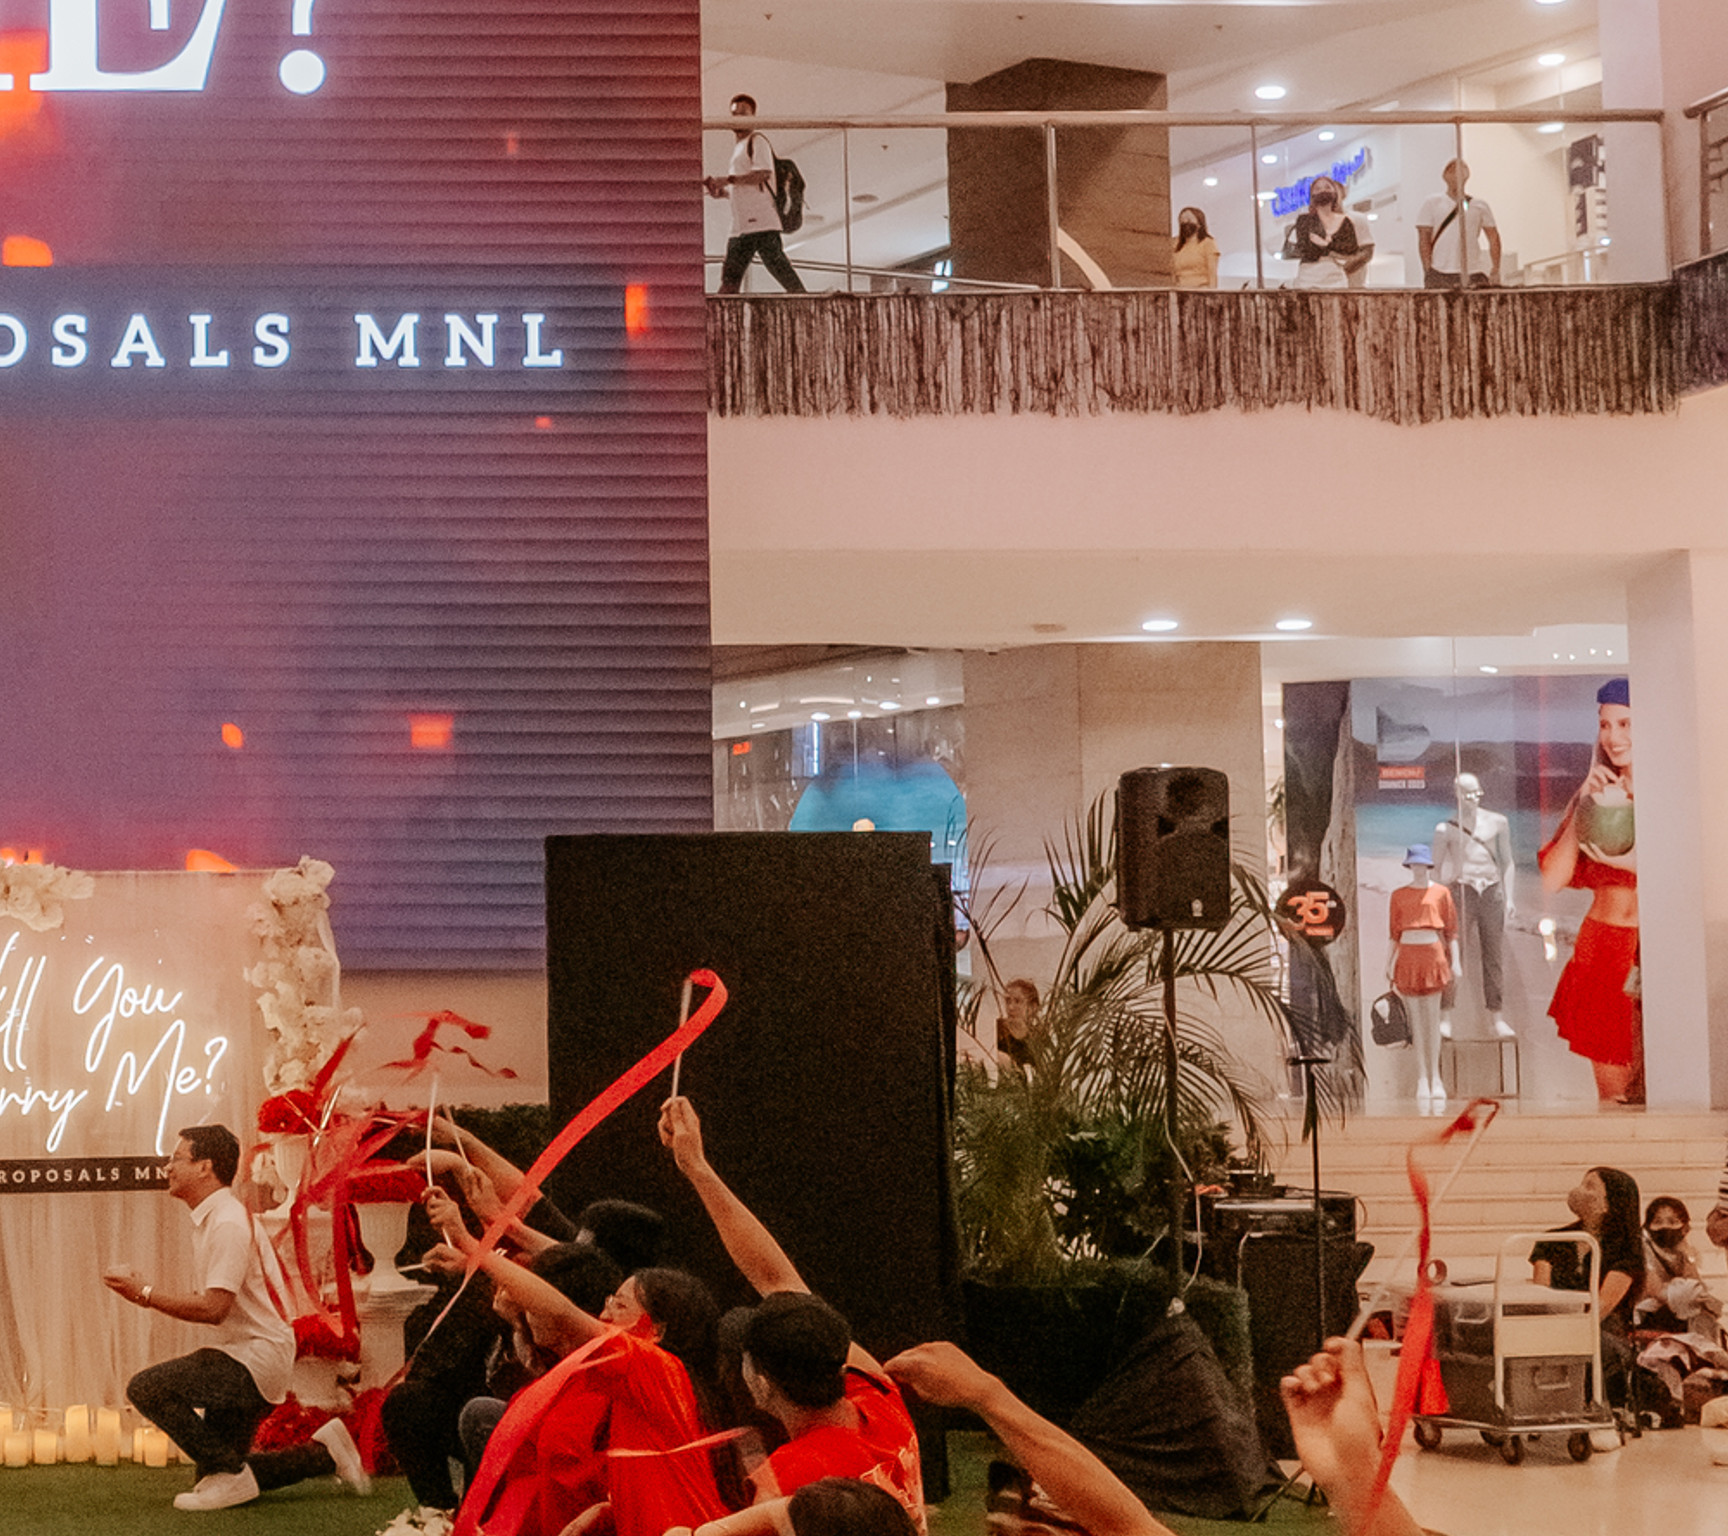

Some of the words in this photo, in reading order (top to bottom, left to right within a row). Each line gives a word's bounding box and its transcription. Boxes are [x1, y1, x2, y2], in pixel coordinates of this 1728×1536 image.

[354, 312, 564, 370] MNL
[73, 956, 183, 1073] You
[105, 1019, 228, 1157] Me?
[134, 1165, 170, 1181] MN
